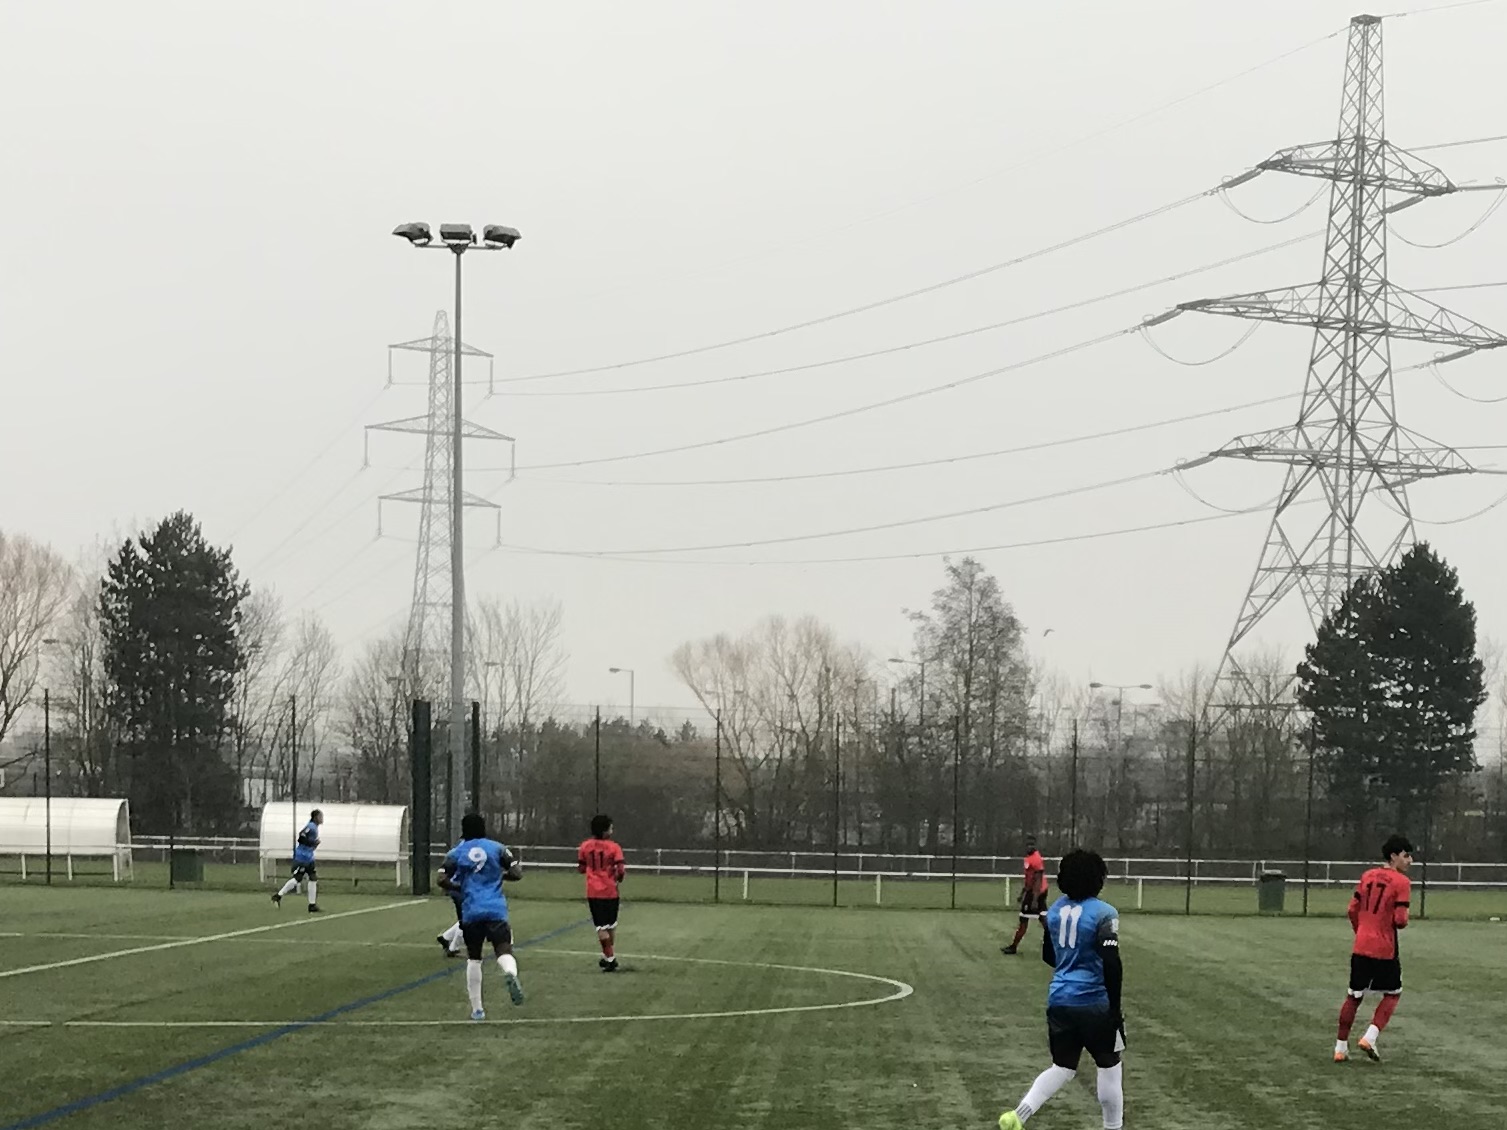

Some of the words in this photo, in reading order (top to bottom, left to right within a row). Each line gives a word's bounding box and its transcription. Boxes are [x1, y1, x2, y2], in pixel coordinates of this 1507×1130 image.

[468, 847, 488, 873] 9
[589, 850, 604, 871] 11
[1366, 881, 1387, 915] 17
[1059, 905, 1083, 949] 11
